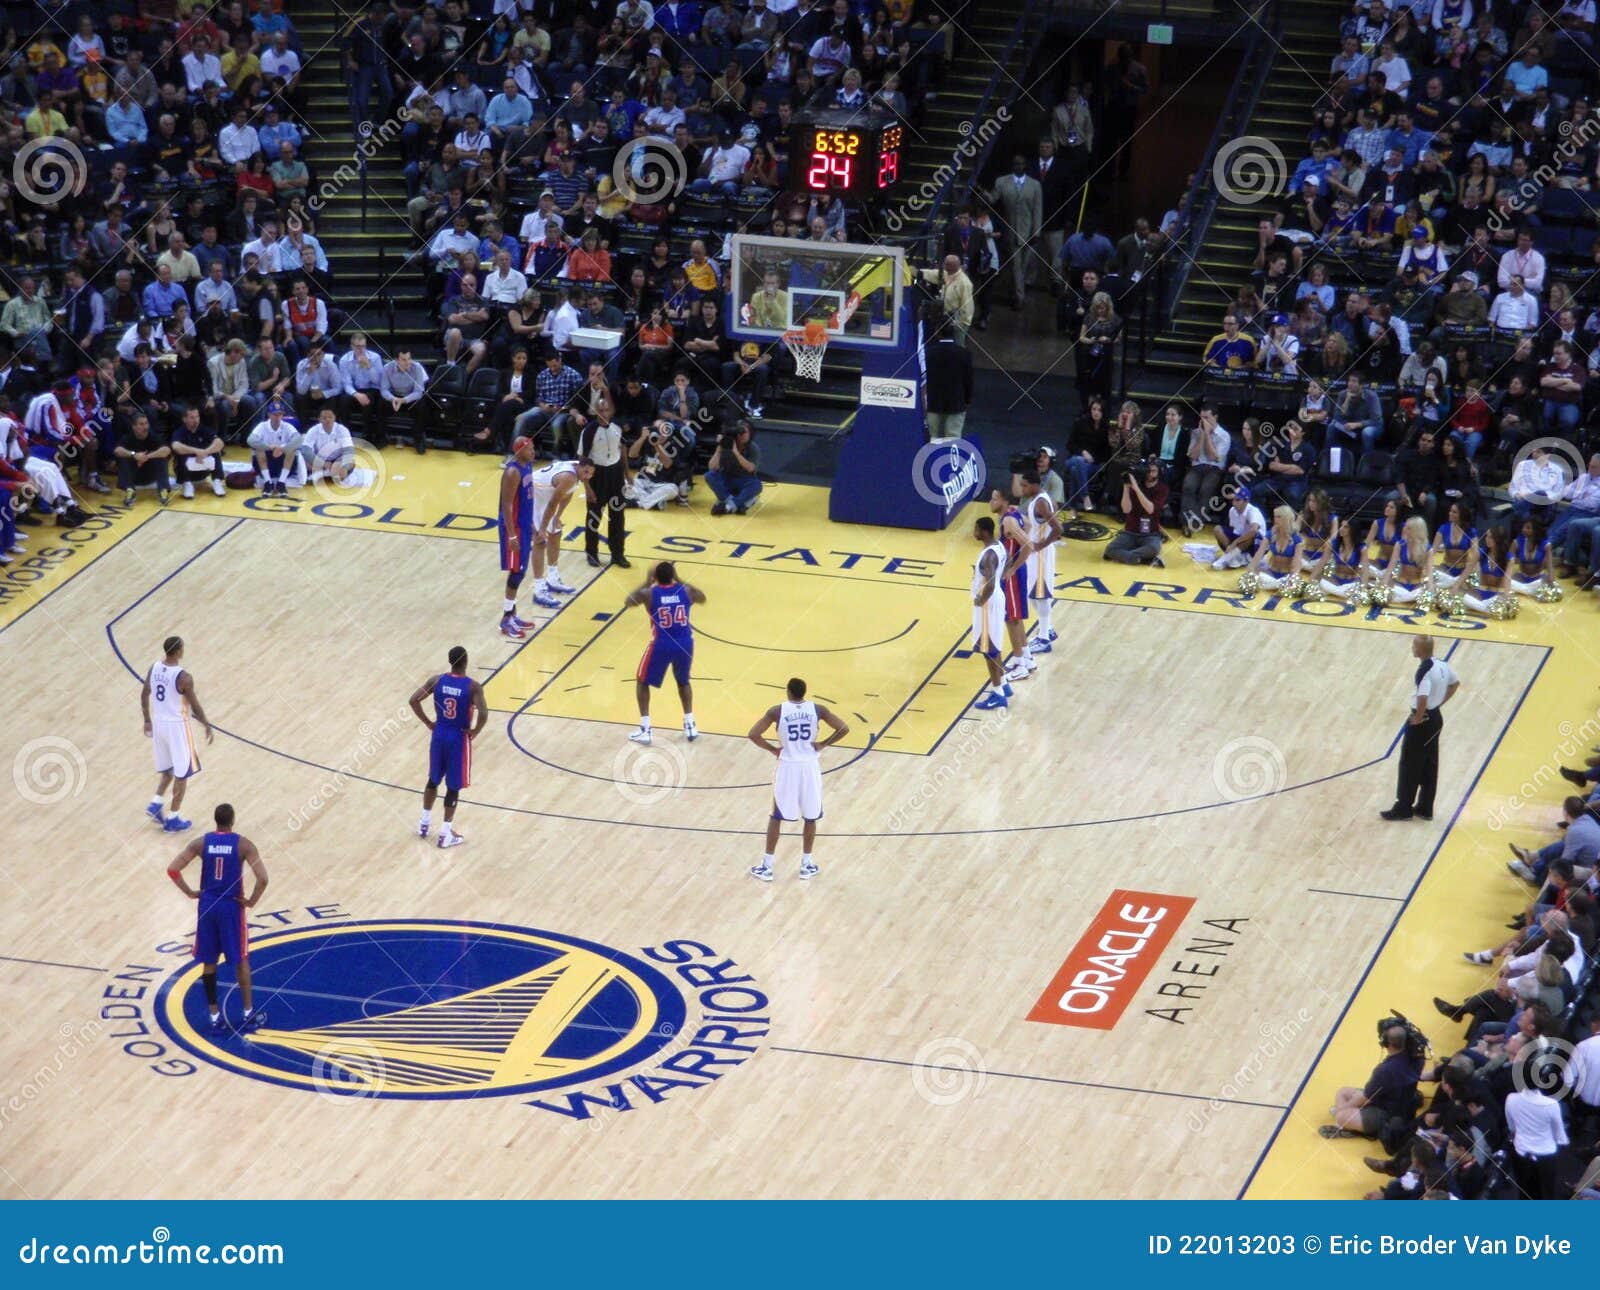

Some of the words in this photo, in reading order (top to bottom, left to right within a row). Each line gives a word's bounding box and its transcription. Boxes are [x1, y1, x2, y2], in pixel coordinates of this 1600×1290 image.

[816, 132, 859, 155] 6:52
[809, 153, 850, 188] 24
[879, 150, 898, 188] 24
[243, 495, 632, 546] GOLDN
[653, 535, 945, 579] STATE
[1052, 574, 1488, 631] ARRIORS
[658, 605, 687, 629] 54
[156, 684, 166, 702] 8
[443, 697, 457, 719] 3
[787, 723, 812, 742] 55
[215, 856, 224, 880] 1
[1058, 903, 1168, 1014] ORACLE
[1145, 917, 1250, 1025] ARENA
[101, 964, 198, 1077] GOLDEN
[155, 903, 352, 957] STE
[520, 939, 770, 1121] WARRIORS
